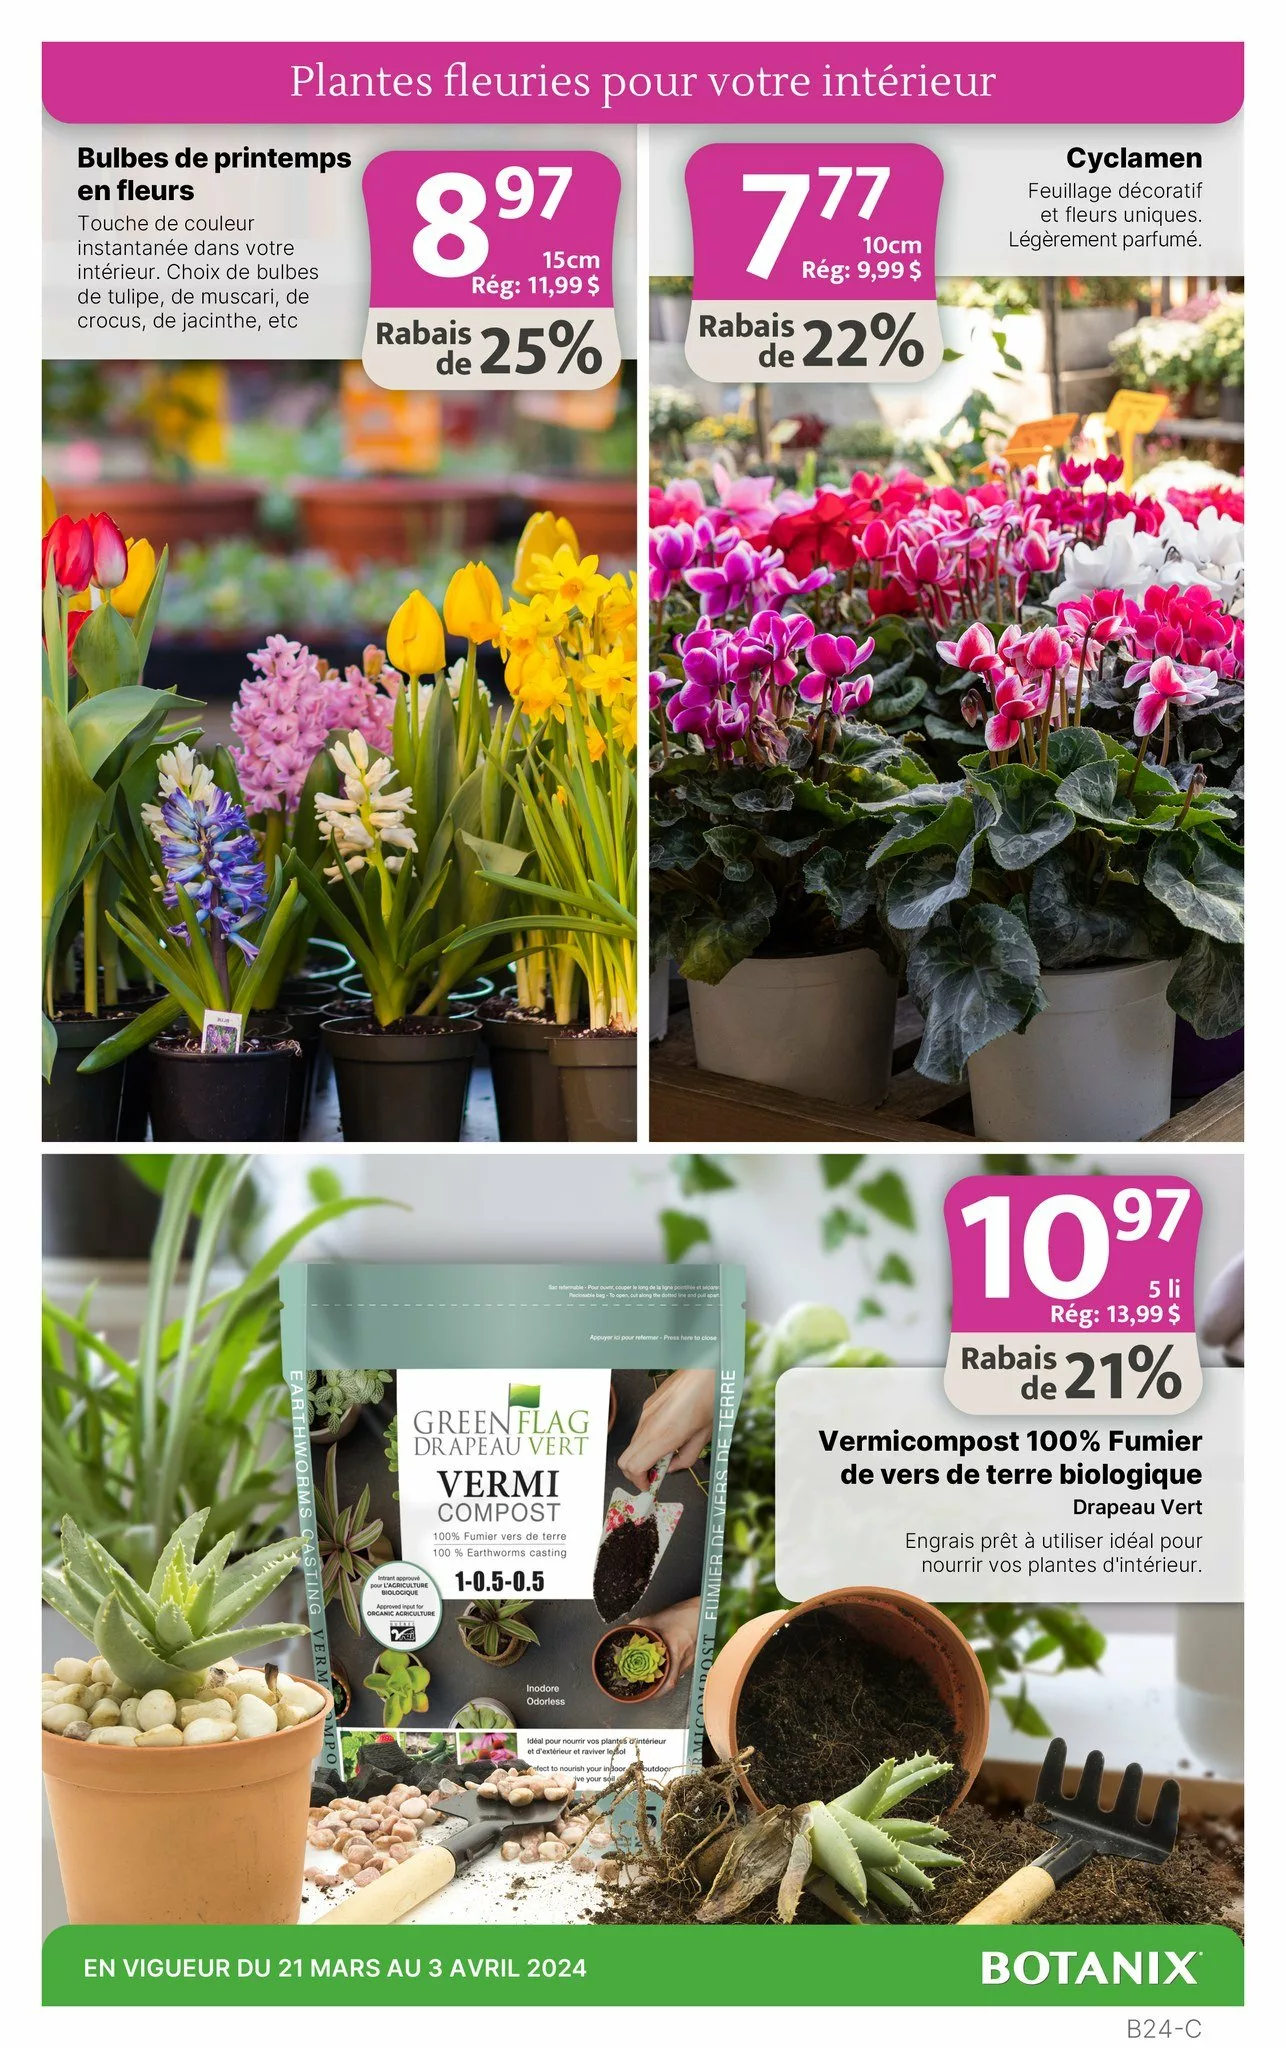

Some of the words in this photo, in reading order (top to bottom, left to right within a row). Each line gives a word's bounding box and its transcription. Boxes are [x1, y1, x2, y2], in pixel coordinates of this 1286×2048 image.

[413, 172, 489, 279] 8
[495, 166, 572, 220] 97
[743, 174, 810, 280] 7
[818, 167, 890, 220] 77
[863, 236, 921, 254] 10cm
[543, 251, 599, 268] 15cm
[803, 259, 850, 284] Rég:
[857, 261, 904, 282] 9,99
[910, 260, 921, 282] $
[471, 276, 520, 300] Rég:
[528, 276, 582, 298] 11,99
[588, 274, 599, 296] $
[377, 320, 471, 345] Rabais
[700, 312, 794, 337] Rabais
[480, 320, 602, 374] 25%
[803, 312, 924, 367] 22%
[437, 350, 471, 375] de
[759, 342, 794, 368] de
[961, 1194, 1109, 1299] 10
[1113, 1188, 1191, 1243] 97
[1149, 1281, 1160, 1298] 5
[1169, 1279, 1180, 1298] li
[1052, 1303, 1099, 1328] Rég:
[1107, 1304, 1163, 1327] 13,99
[1169, 1303, 1180, 1325] $
[962, 1344, 1057, 1370] Rabais
[1065, 1344, 1182, 1399] 21%
[718, 1369, 736, 1431] TERRE
[1021, 1375, 1057, 1400] de
[414, 1409, 509, 1435] GREEN
[517, 1410, 588, 1434] FLAG
[290, 1370, 312, 1519] EARTHWORMS
[415, 1437, 520, 1455] DRAPEAU
[529, 1437, 588, 1455] VERT
[437, 1470, 559, 1498] VERMI
[438, 1503, 560, 1522] COMPOST
[434, 1532, 459, 1540] 100%
[465, 1532, 497, 1540] Fumier
[434, 1549, 450, 1557] 100
[455, 1549, 463, 1557] %
[468, 1549, 525, 1557] Earthworms
[530, 1549, 566, 1559] casting
[455, 1571, 544, 1592] 1-0.5-0.5
[527, 1697, 565, 1705] Odorless
[527, 1737, 544, 1745] Idéal
[545, 1739, 561, 1747] pour
[586, 1766, 602, 1774] your
